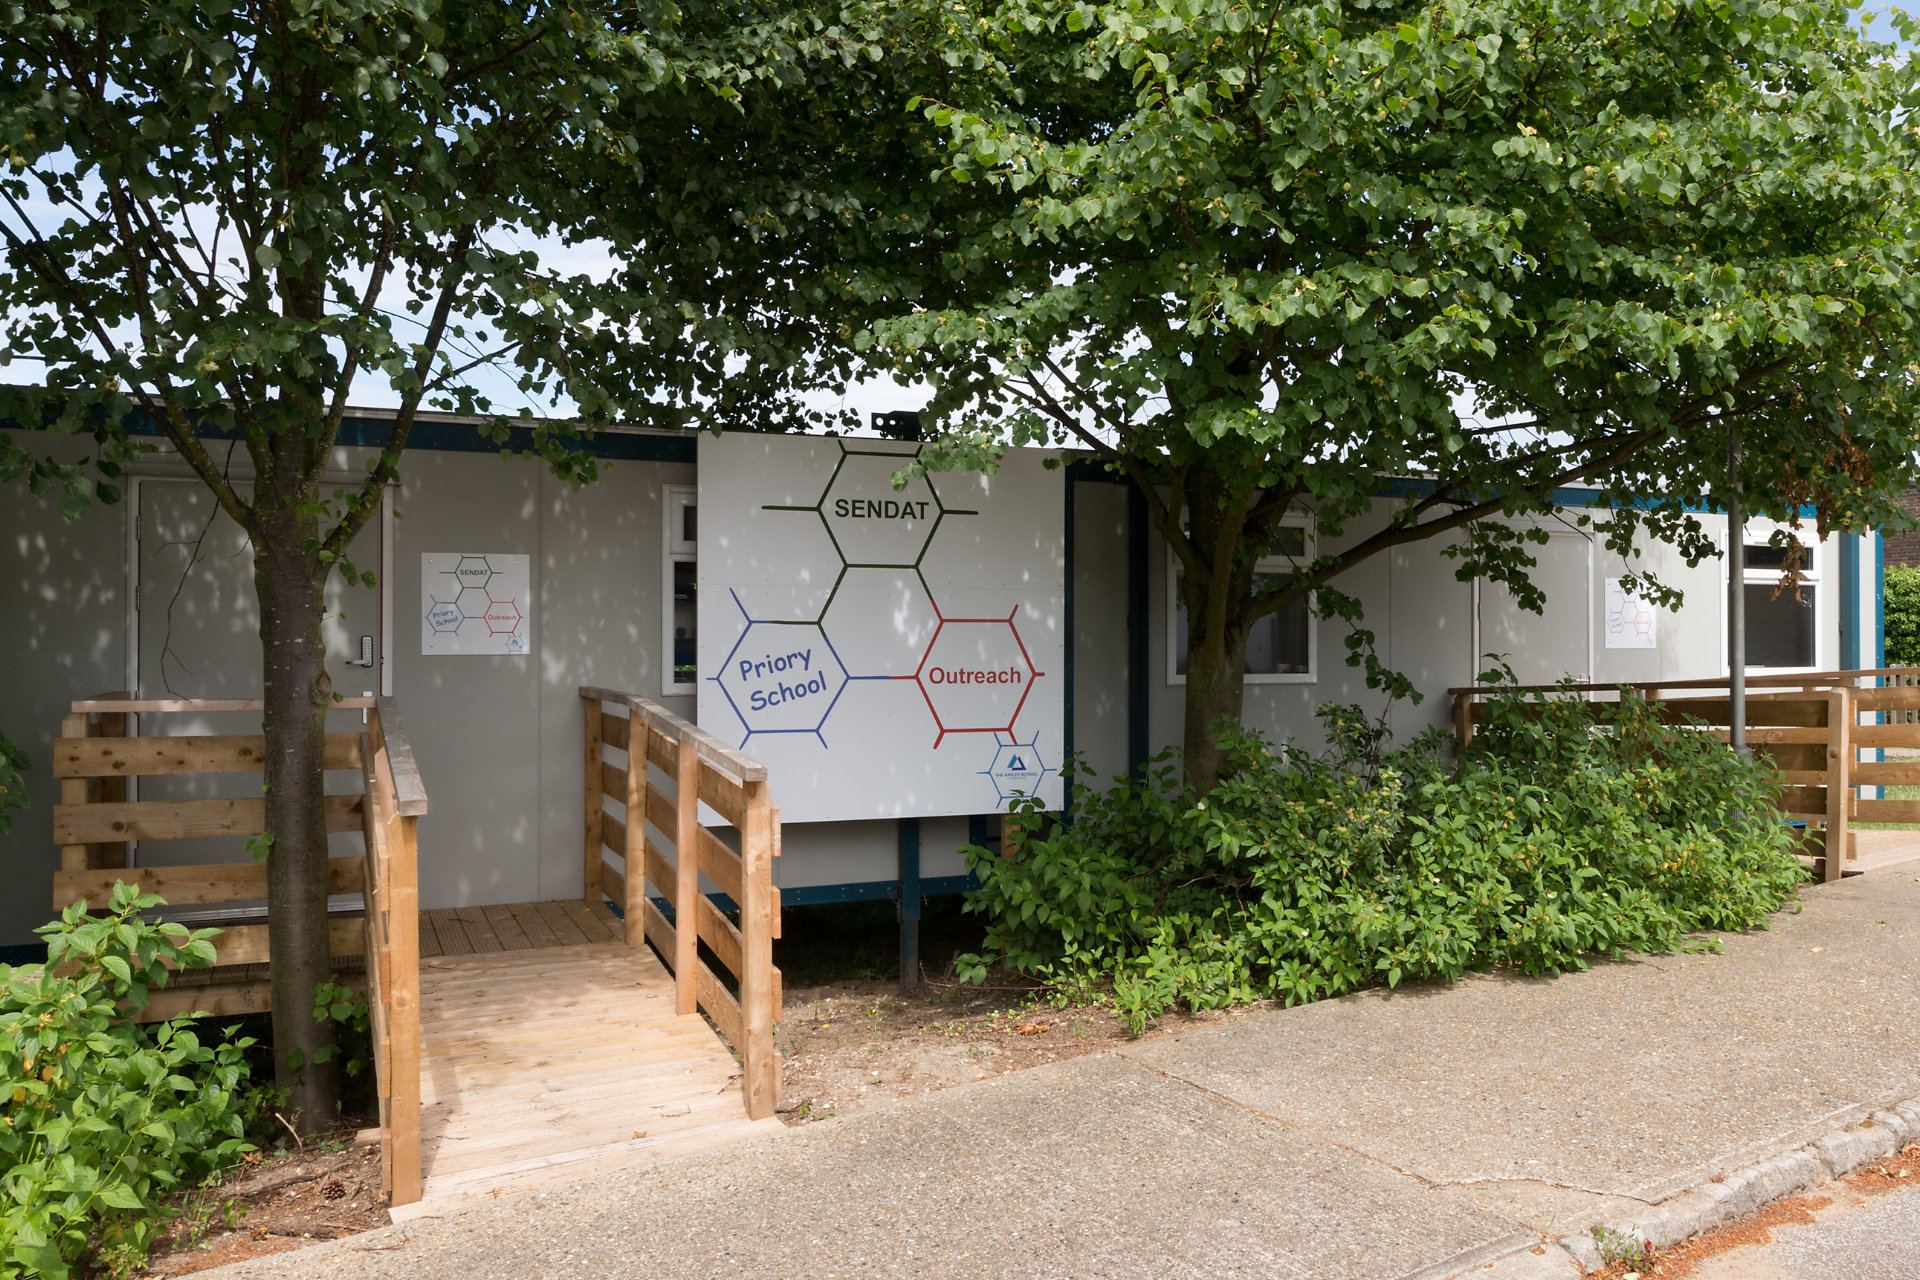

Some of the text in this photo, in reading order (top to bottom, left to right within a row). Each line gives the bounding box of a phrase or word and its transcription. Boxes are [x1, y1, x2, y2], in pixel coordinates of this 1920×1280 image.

[834, 498, 930, 520] SENDAT
[433, 610, 454, 618] Priory
[436, 616, 458, 627] School
[740, 648, 811, 681] Priory
[928, 667, 1021, 685] Outreach
[750, 670, 828, 711] School
